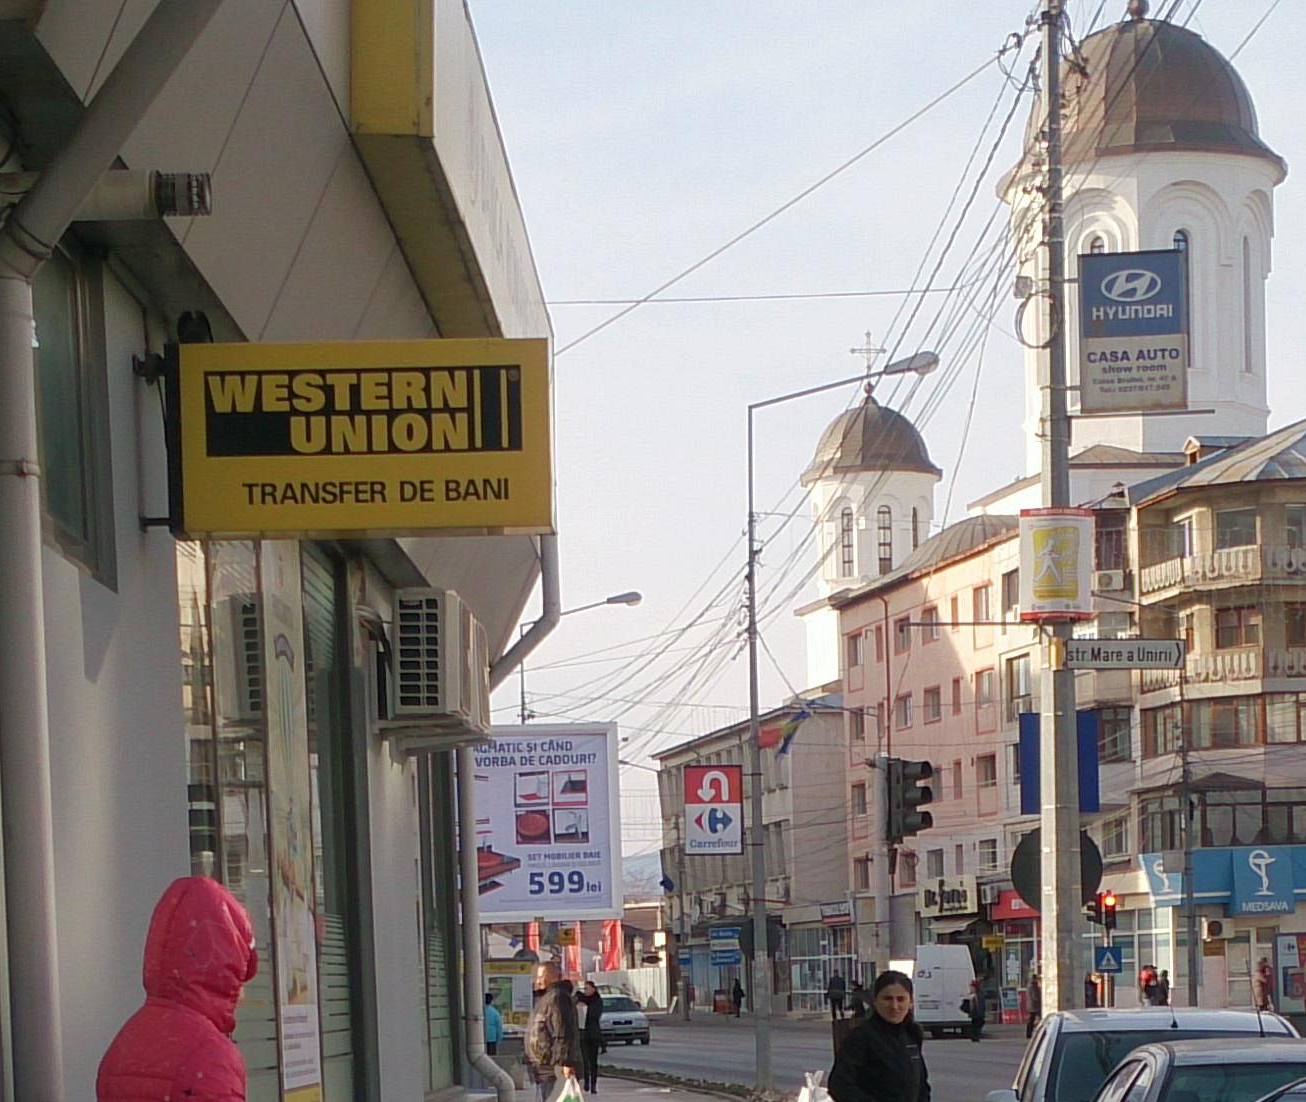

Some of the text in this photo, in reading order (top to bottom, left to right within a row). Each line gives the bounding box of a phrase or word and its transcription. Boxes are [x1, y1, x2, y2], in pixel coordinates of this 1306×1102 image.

[1092, 304, 1173, 320] HYUNDAI
[1087, 348, 1180, 363] CASA AUTO
[1102, 364, 1167, 374] show room
[207, 369, 469, 413] WESTERN
[290, 412, 469, 453] UNION
[242, 478, 510, 505] TRANSFER DE BANI
[1091, 647, 1123, 661] Mare
[1126, 650, 1134, 661] a
[1137, 647, 1172, 661] Unirii
[475, 753, 597, 767] VORBA DE CADOURI?
[689, 838, 739, 848] Carrefour
[528, 870, 602, 895] 599 lei
[1241, 901, 1289, 912] MEDSAVA
